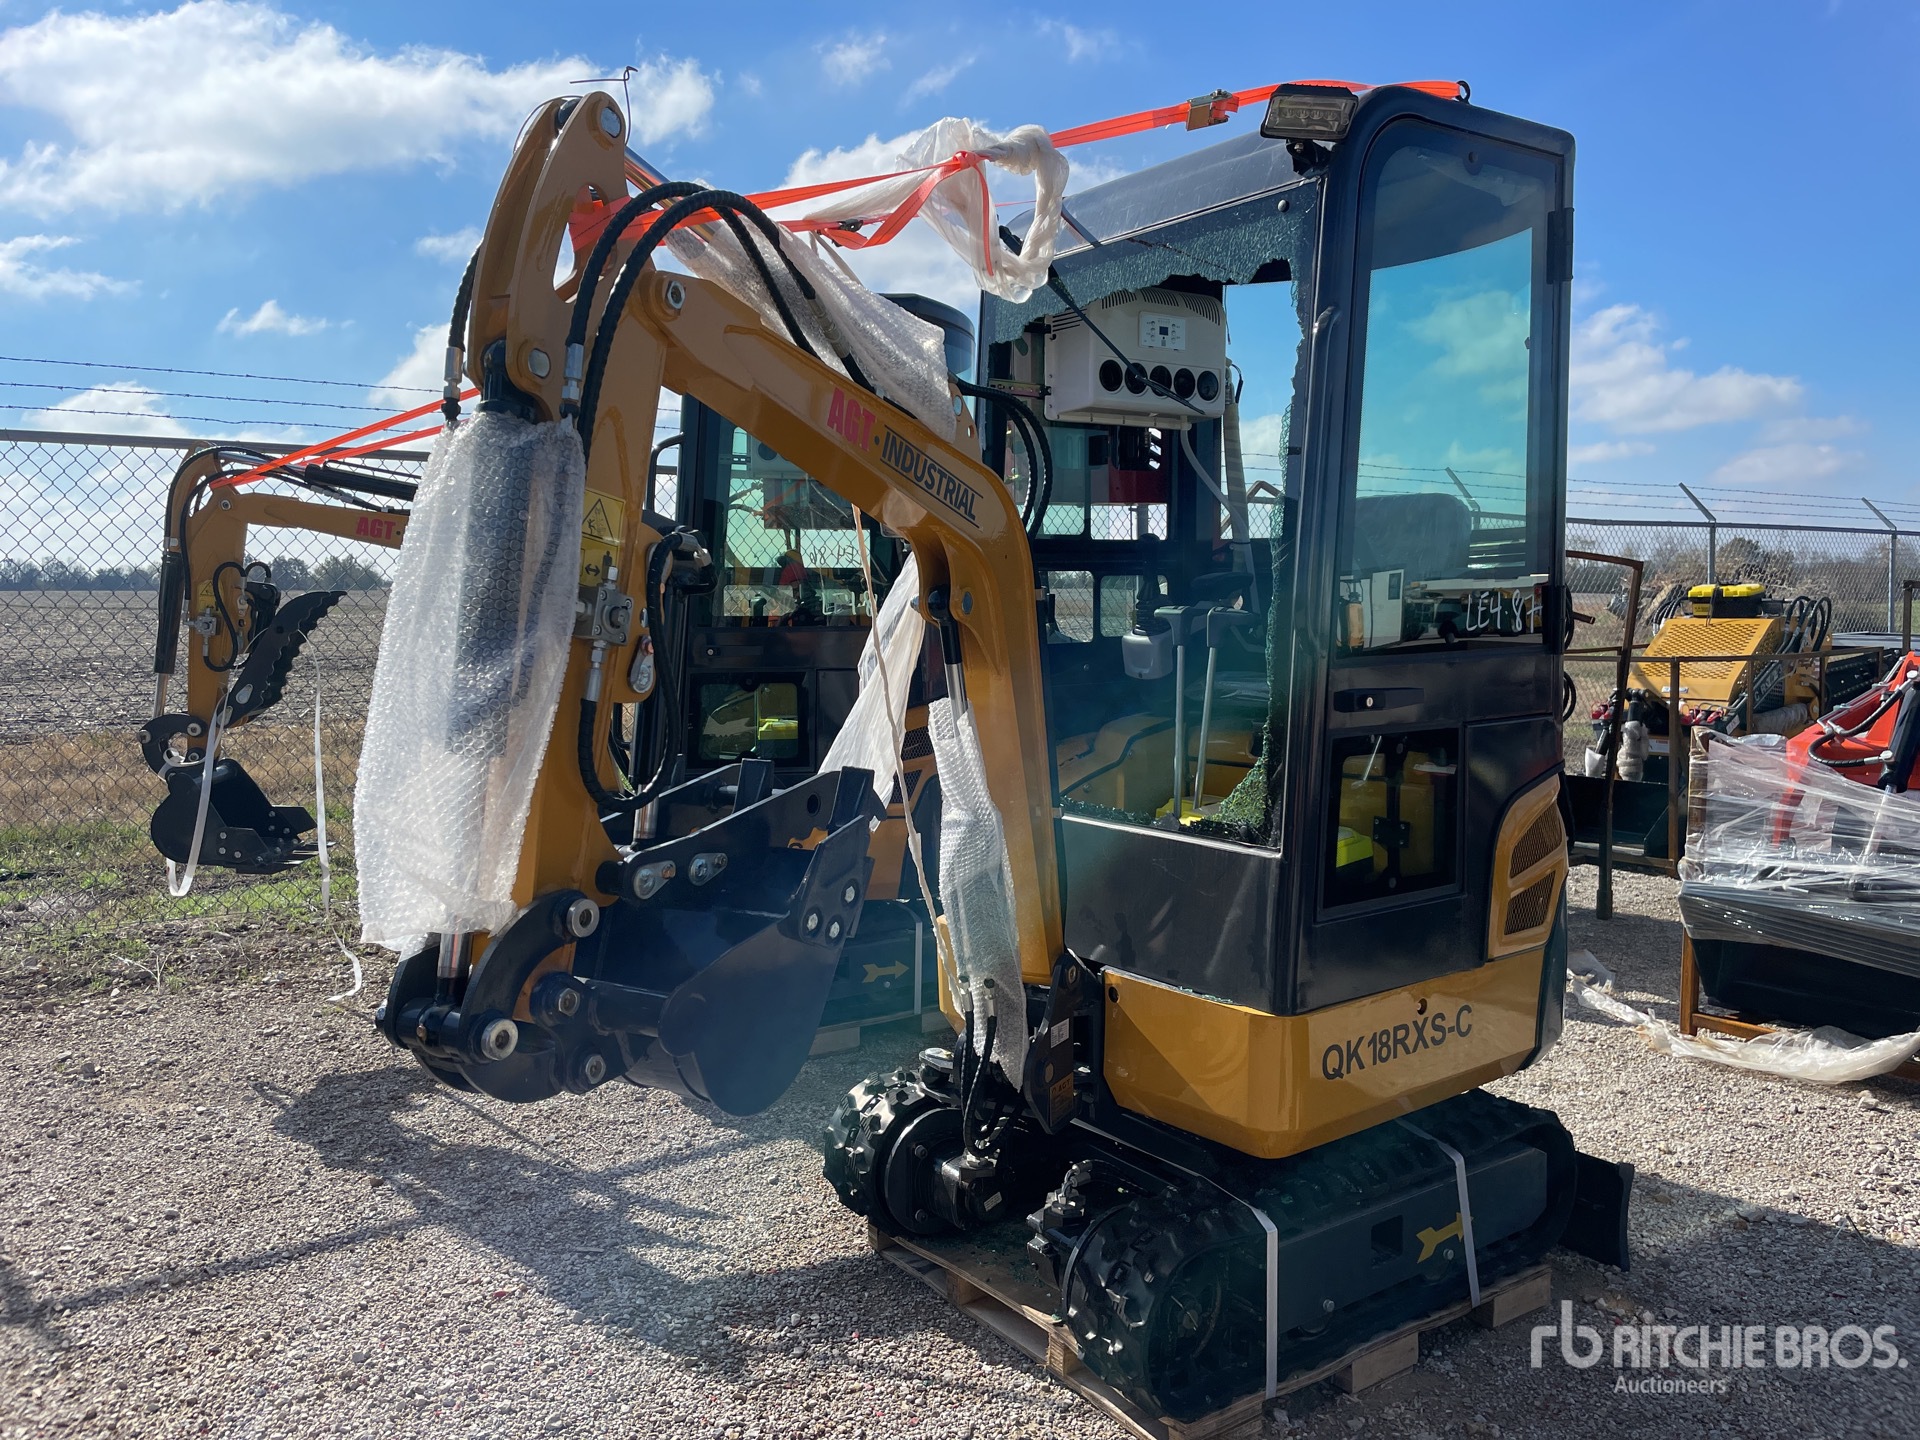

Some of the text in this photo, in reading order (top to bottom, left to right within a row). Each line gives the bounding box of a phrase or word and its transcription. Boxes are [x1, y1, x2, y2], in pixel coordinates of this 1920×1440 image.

[826, 387, 977, 521] AGT INDUSTRIAL
[355, 516, 396, 540] AGT
[1322, 1004, 1473, 1081] QK18RXS-C
